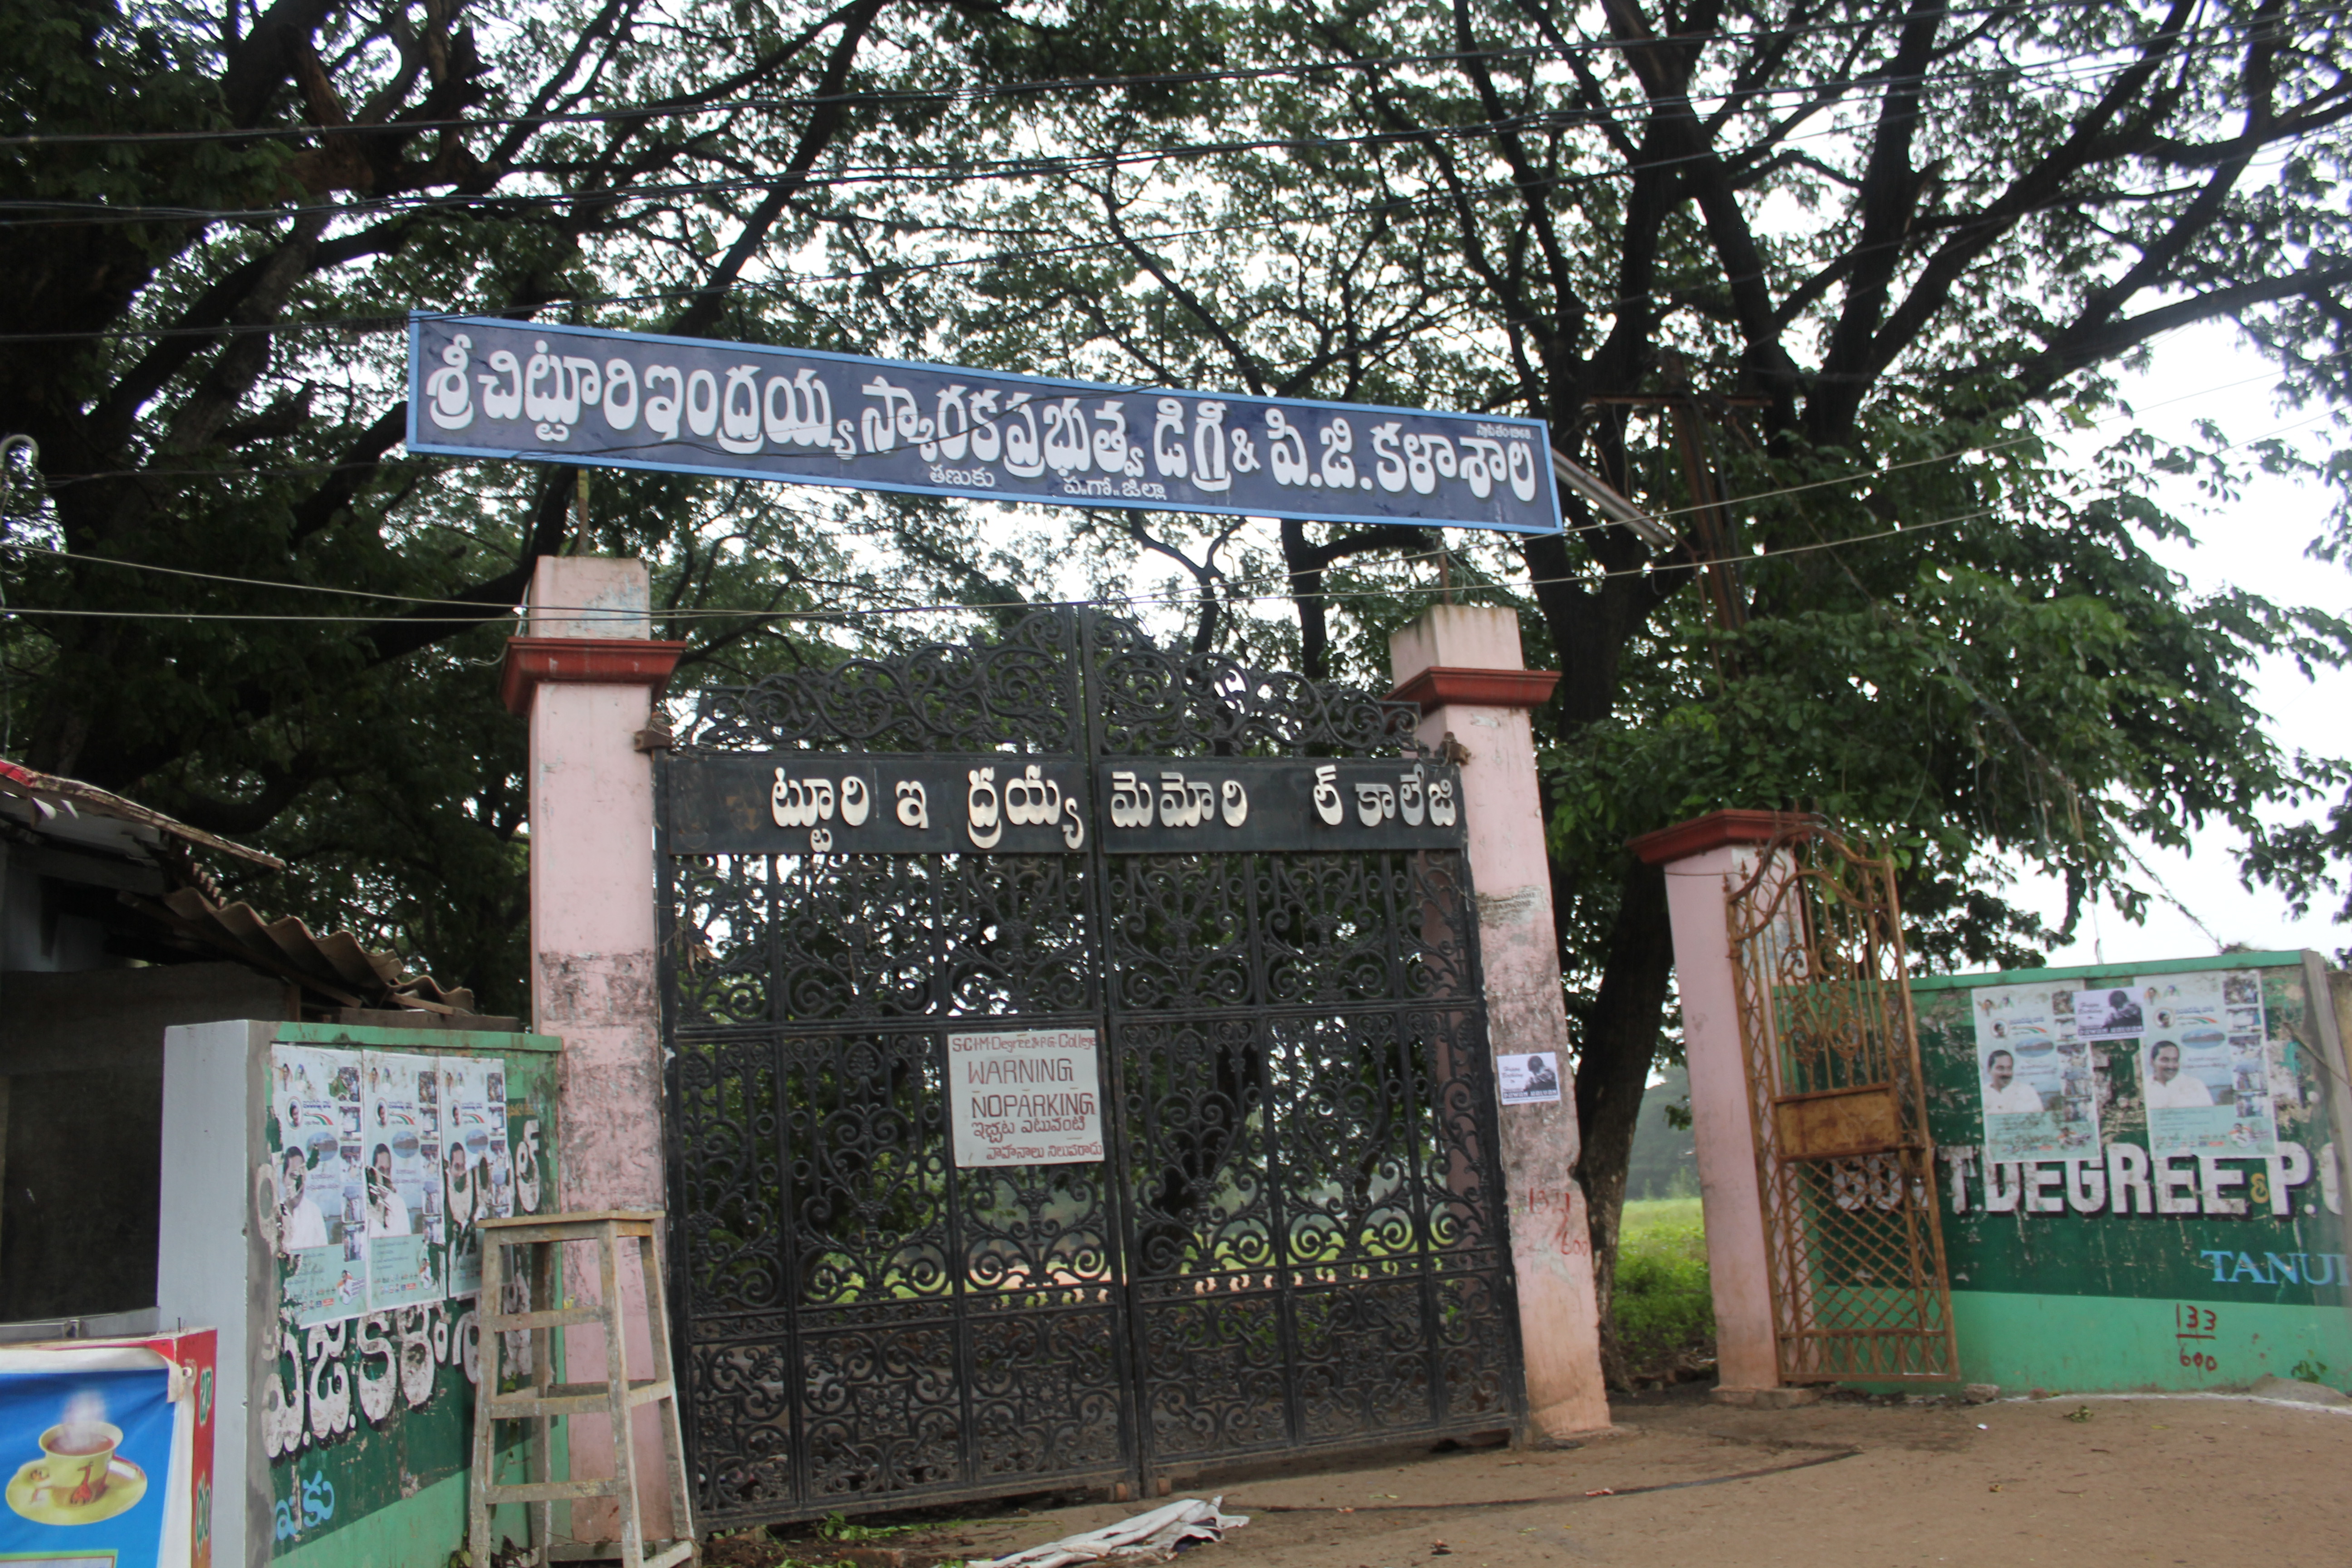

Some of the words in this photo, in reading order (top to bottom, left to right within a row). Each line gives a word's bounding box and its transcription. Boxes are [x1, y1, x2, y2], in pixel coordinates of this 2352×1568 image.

[426, 333, 475, 430] శ్రీ
[1230, 427, 1261, 474] &
[968, 1058, 1073, 1085] WARNING
